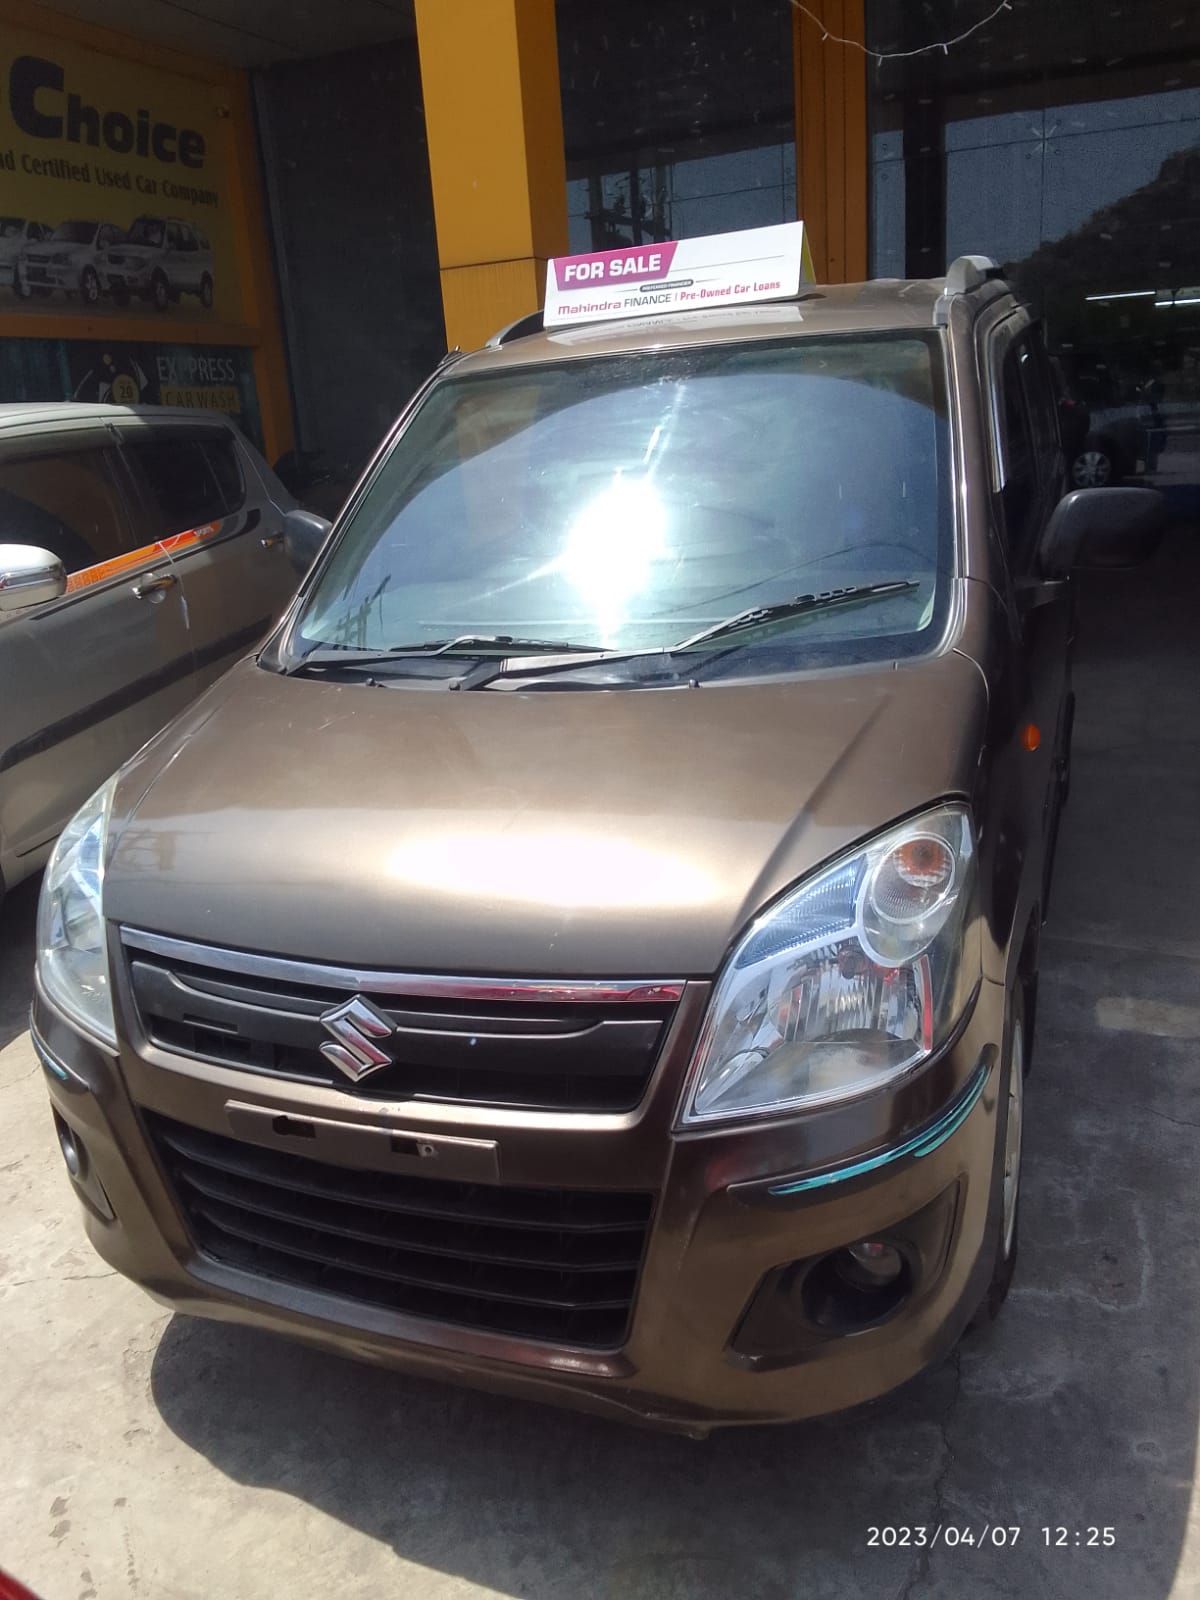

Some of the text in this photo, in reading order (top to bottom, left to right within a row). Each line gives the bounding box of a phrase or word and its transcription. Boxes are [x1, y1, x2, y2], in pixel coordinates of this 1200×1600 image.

[9, 55, 205, 169] Choice
[21, 153, 90, 184] Certified
[95, 167, 132, 190] Used
[136, 175, 157, 195] Car
[162, 180, 219, 208] Company
[564, 254, 661, 282] FOR SALE
[558, 281, 781, 315] Mahindra FINANCE Pre-Owned Car Loans
